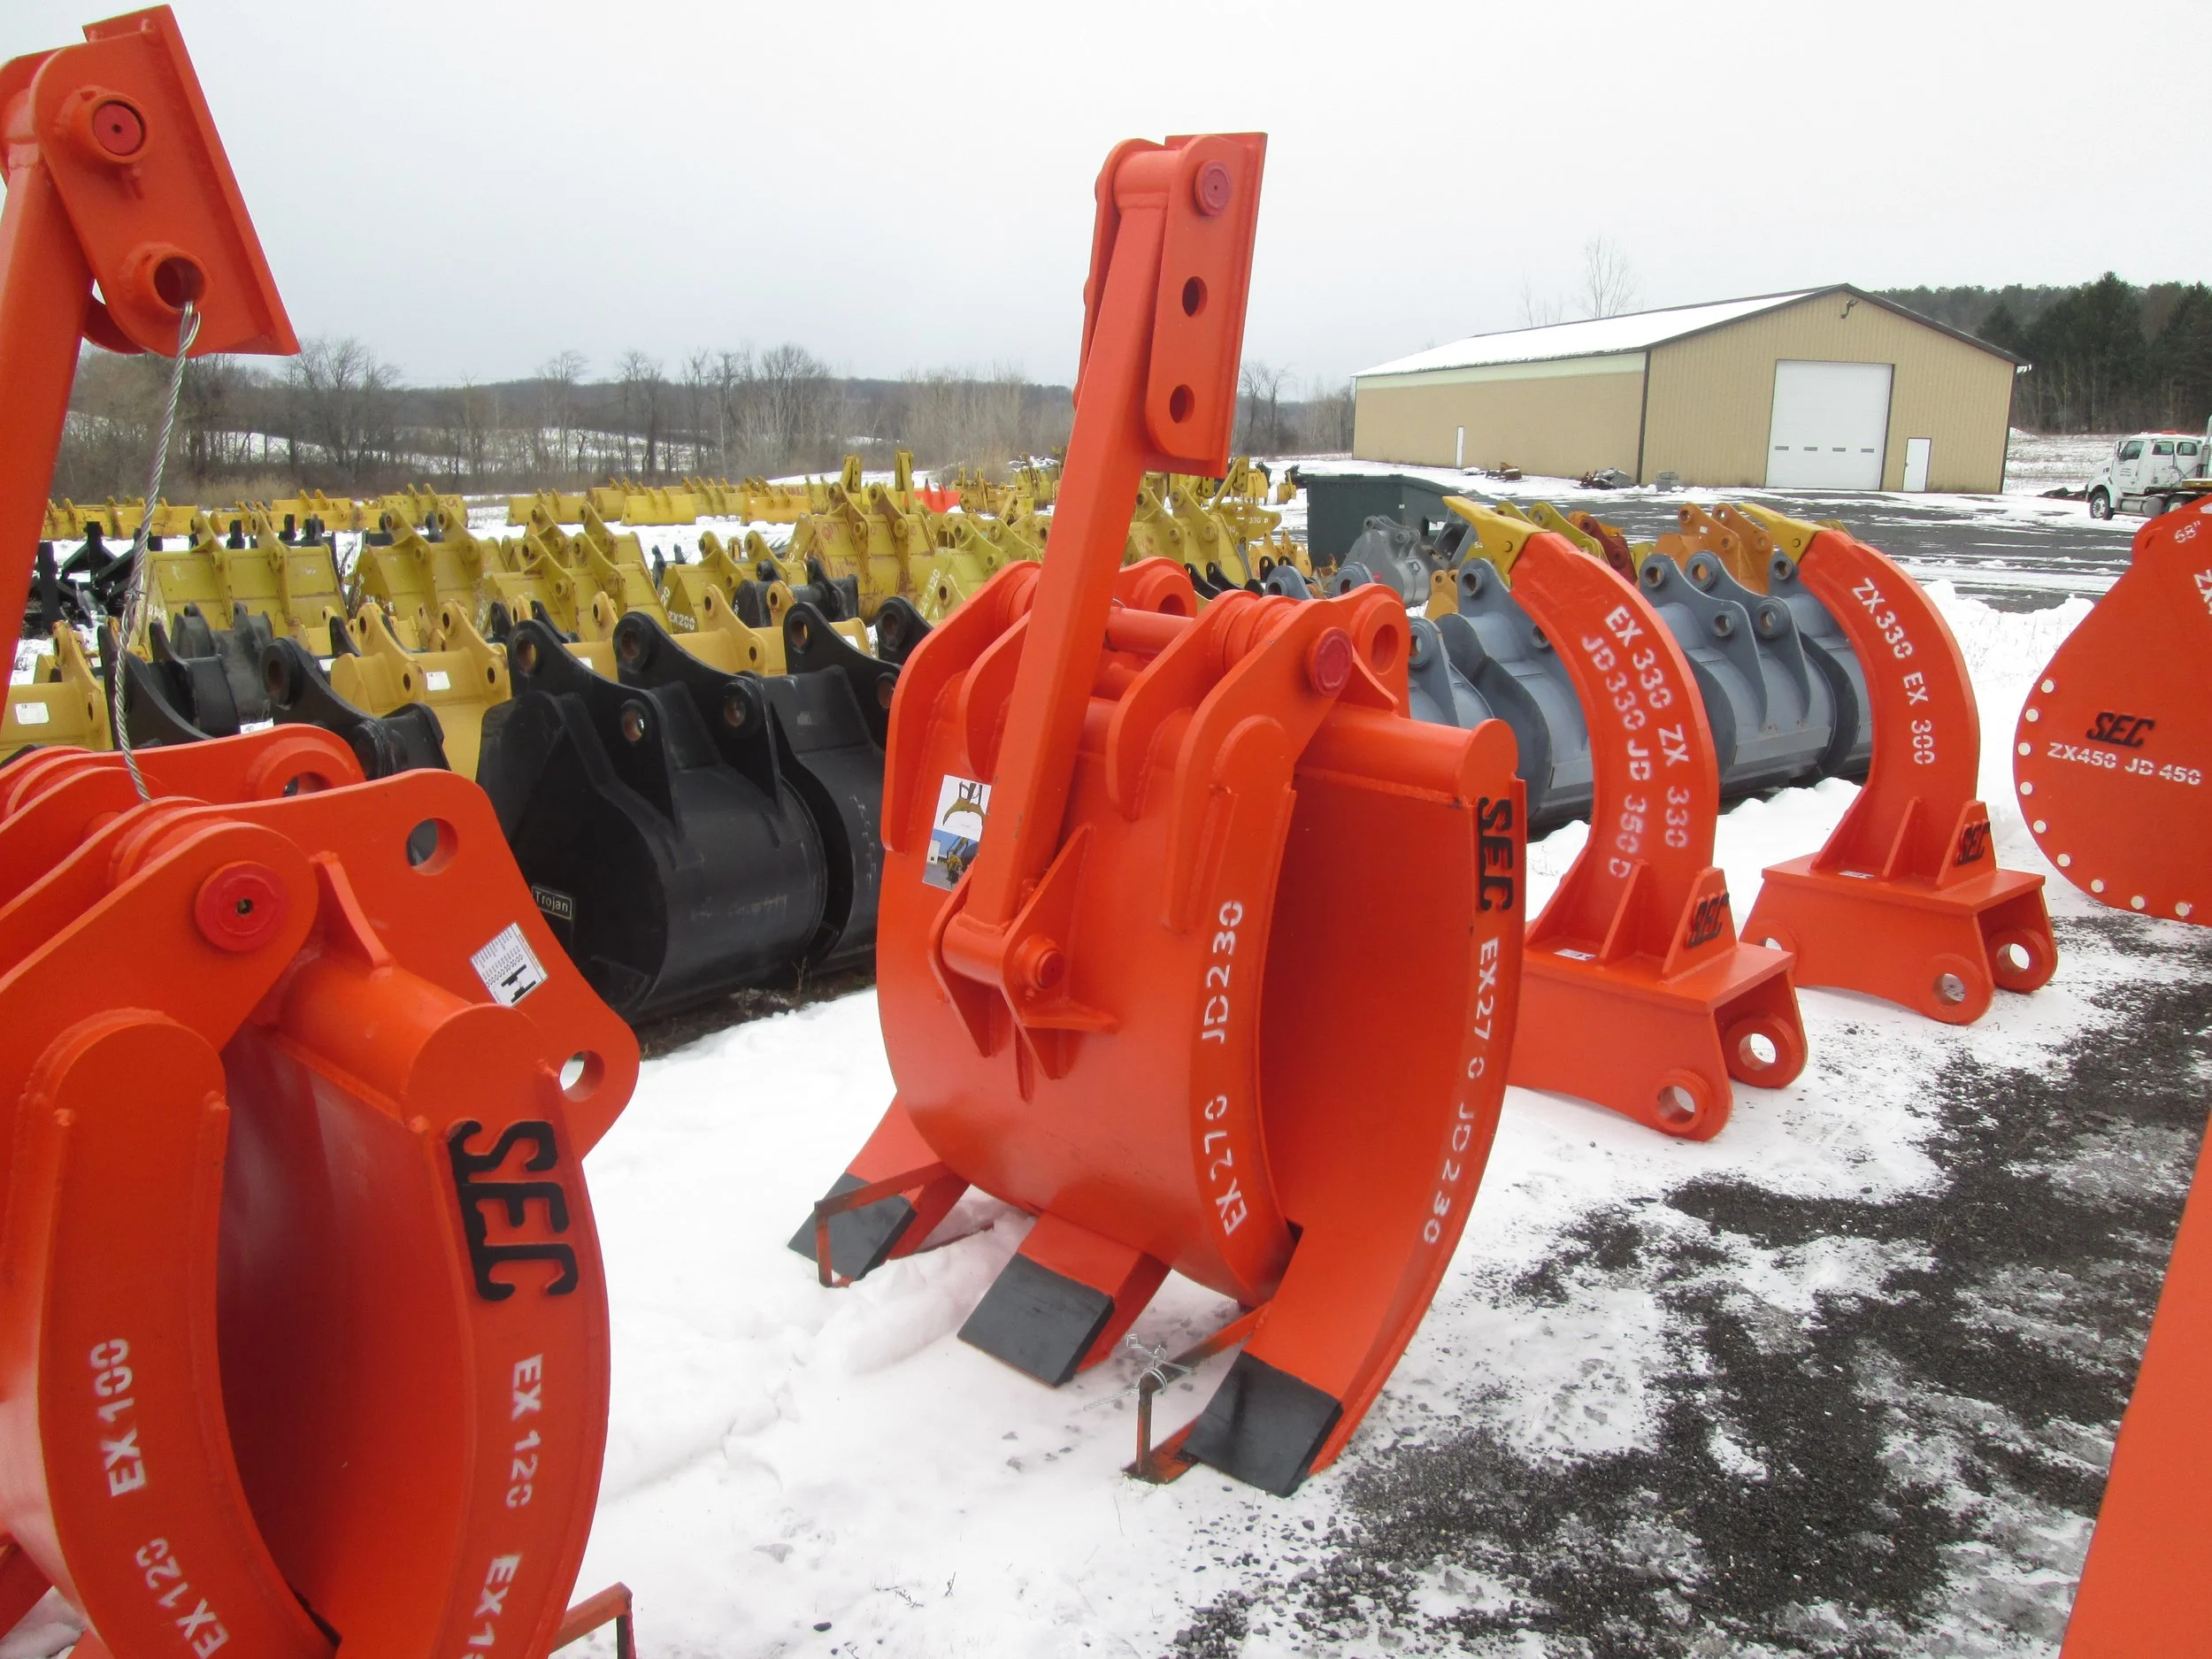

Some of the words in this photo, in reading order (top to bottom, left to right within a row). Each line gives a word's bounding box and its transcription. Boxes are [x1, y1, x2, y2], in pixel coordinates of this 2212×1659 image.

[1605, 605, 1643, 648] EX
[1632, 647, 1672, 710] 330
[1902, 671, 1930, 706] EX
[1657, 723, 1691, 767] ZX
[1910, 719, 1936, 765] 300
[2085, 710, 2155, 748] SEC
[1626, 738, 1651, 781] JD
[2047, 741, 2118, 770] ZX450
[1664, 786, 1691, 849] 330
[1478, 795, 1514, 911] SEC
[534, 890, 568, 912] Trojan
[447, 1118, 579, 1302] SEC
[511, 1353, 543, 1422] EX
[505, 1429, 541, 1509] 120
